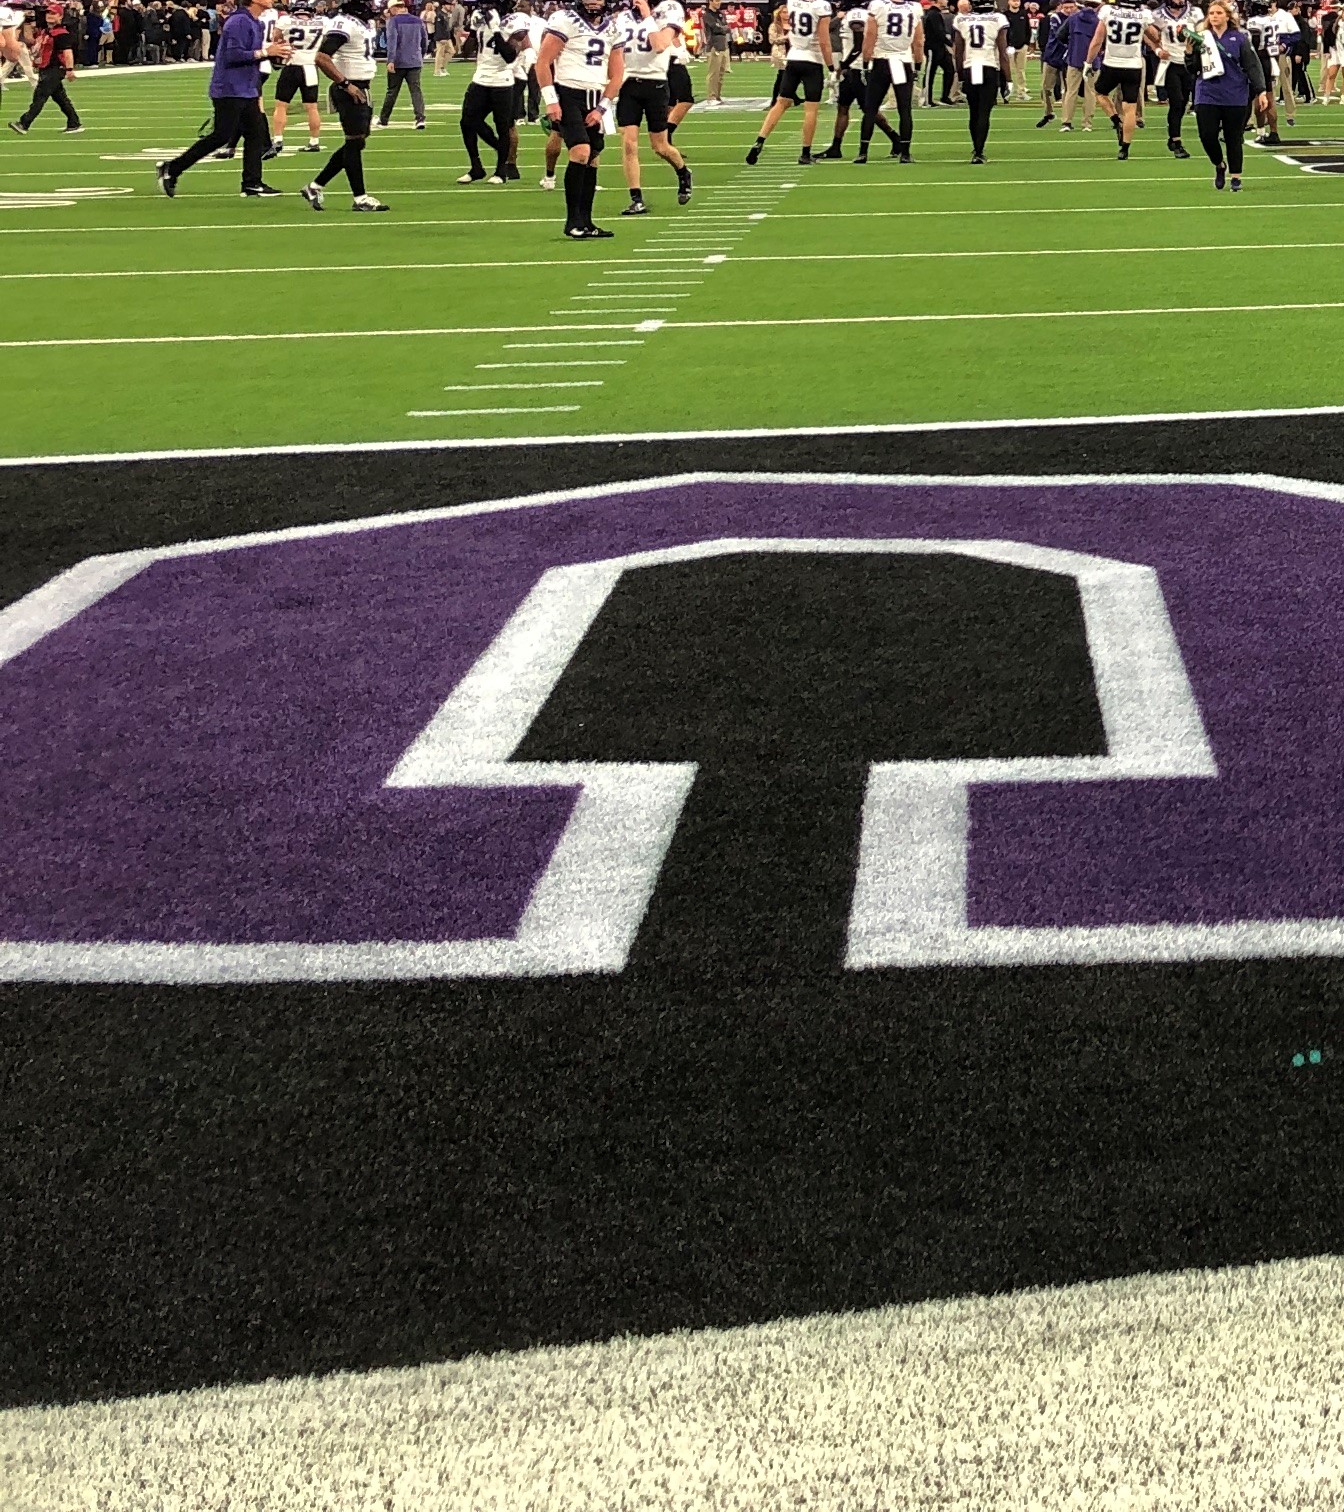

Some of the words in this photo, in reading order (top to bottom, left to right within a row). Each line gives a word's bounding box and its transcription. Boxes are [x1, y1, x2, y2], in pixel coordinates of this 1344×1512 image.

[887, 13, 914, 38] 81
[1107, 19, 1143, 44] 32
[288, 27, 323, 51] 27
[585, 39, 605, 66] 2
